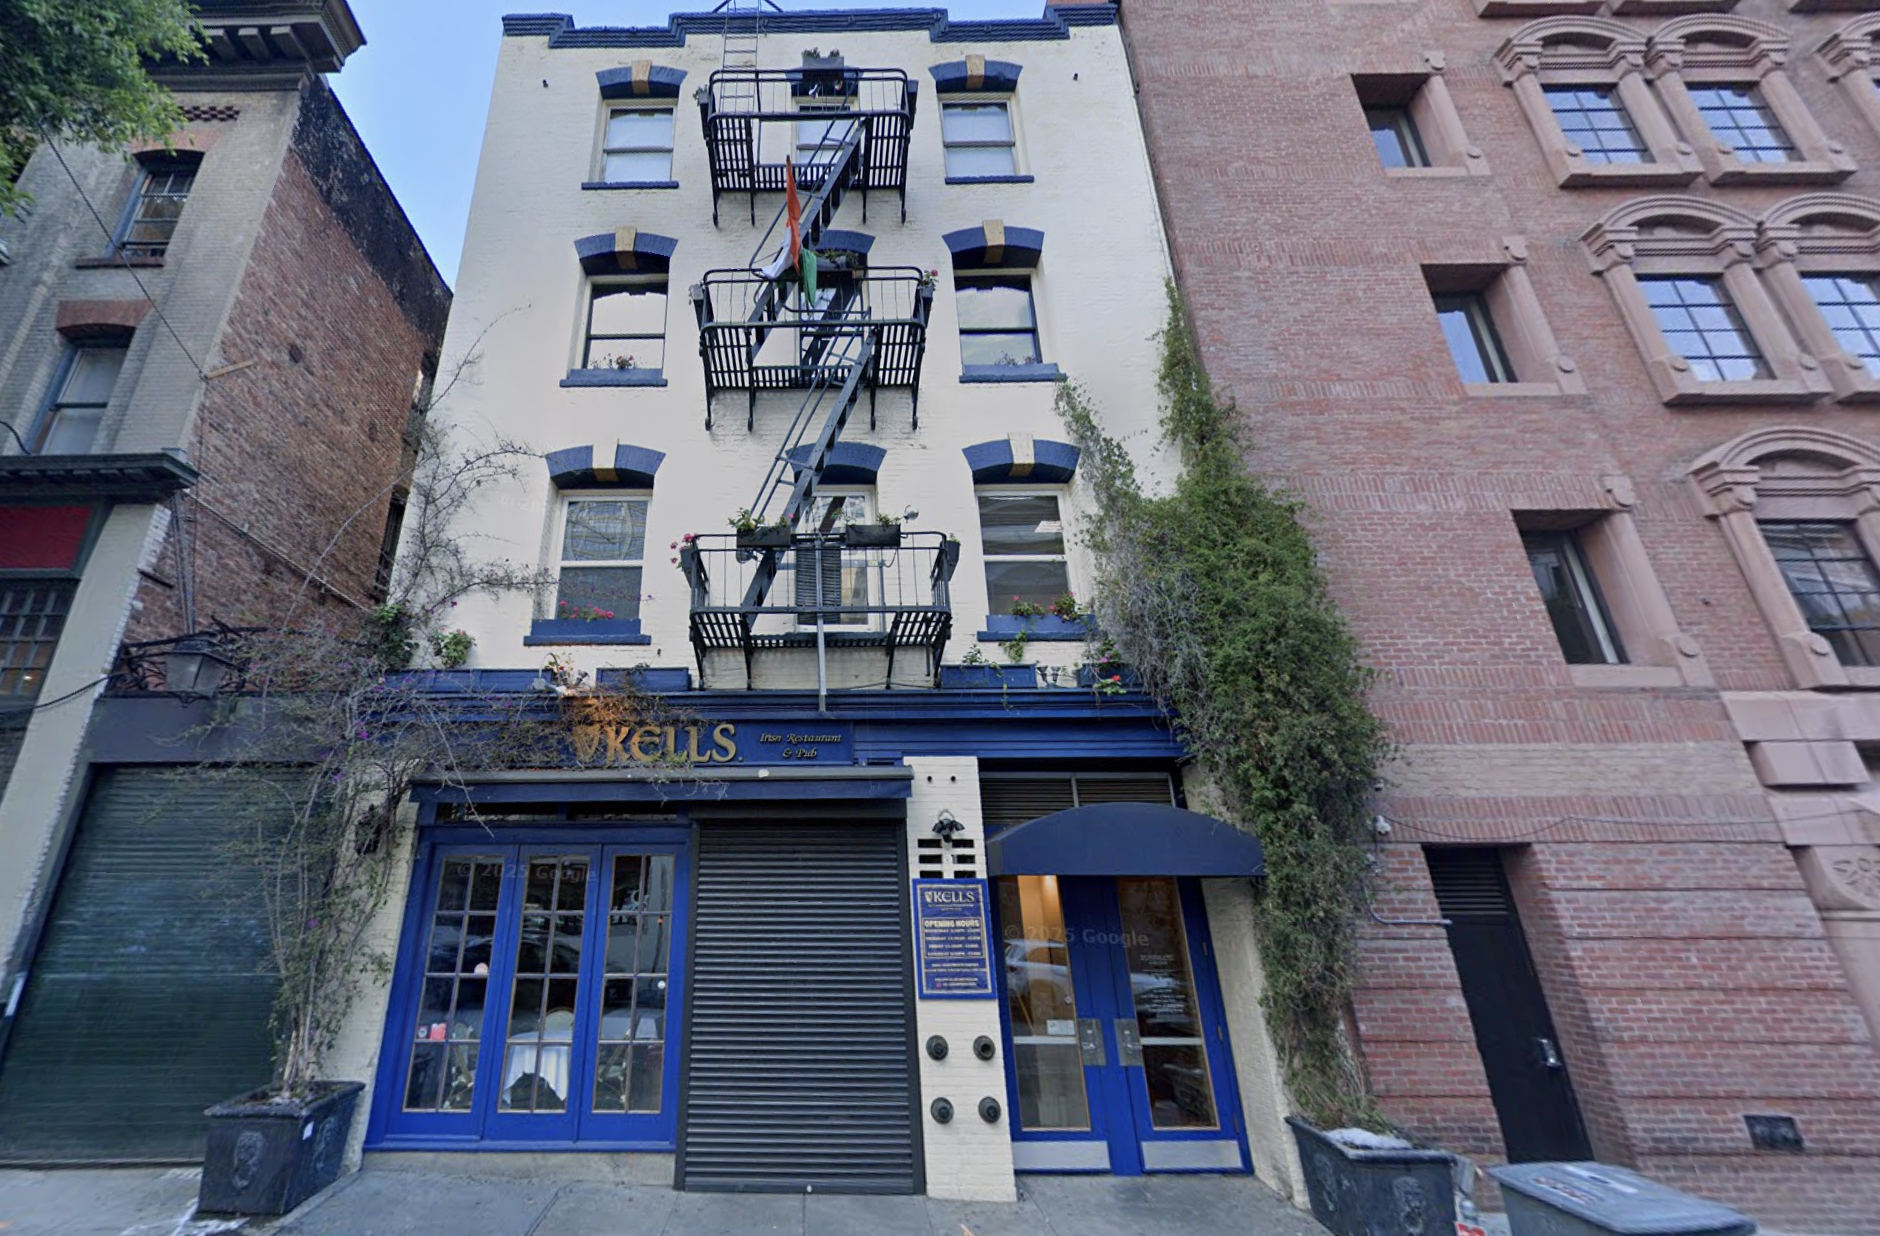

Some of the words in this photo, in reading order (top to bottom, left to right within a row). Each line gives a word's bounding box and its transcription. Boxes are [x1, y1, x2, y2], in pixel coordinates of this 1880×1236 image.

[787, 733, 842, 745] Restaurant
[782, 747, 792, 758] &
[796, 746, 817, 758] Pub
[934, 891, 975, 903] KELLS
[925, 920, 955, 928] OPENING
[956, 920, 980, 928] HOURS
